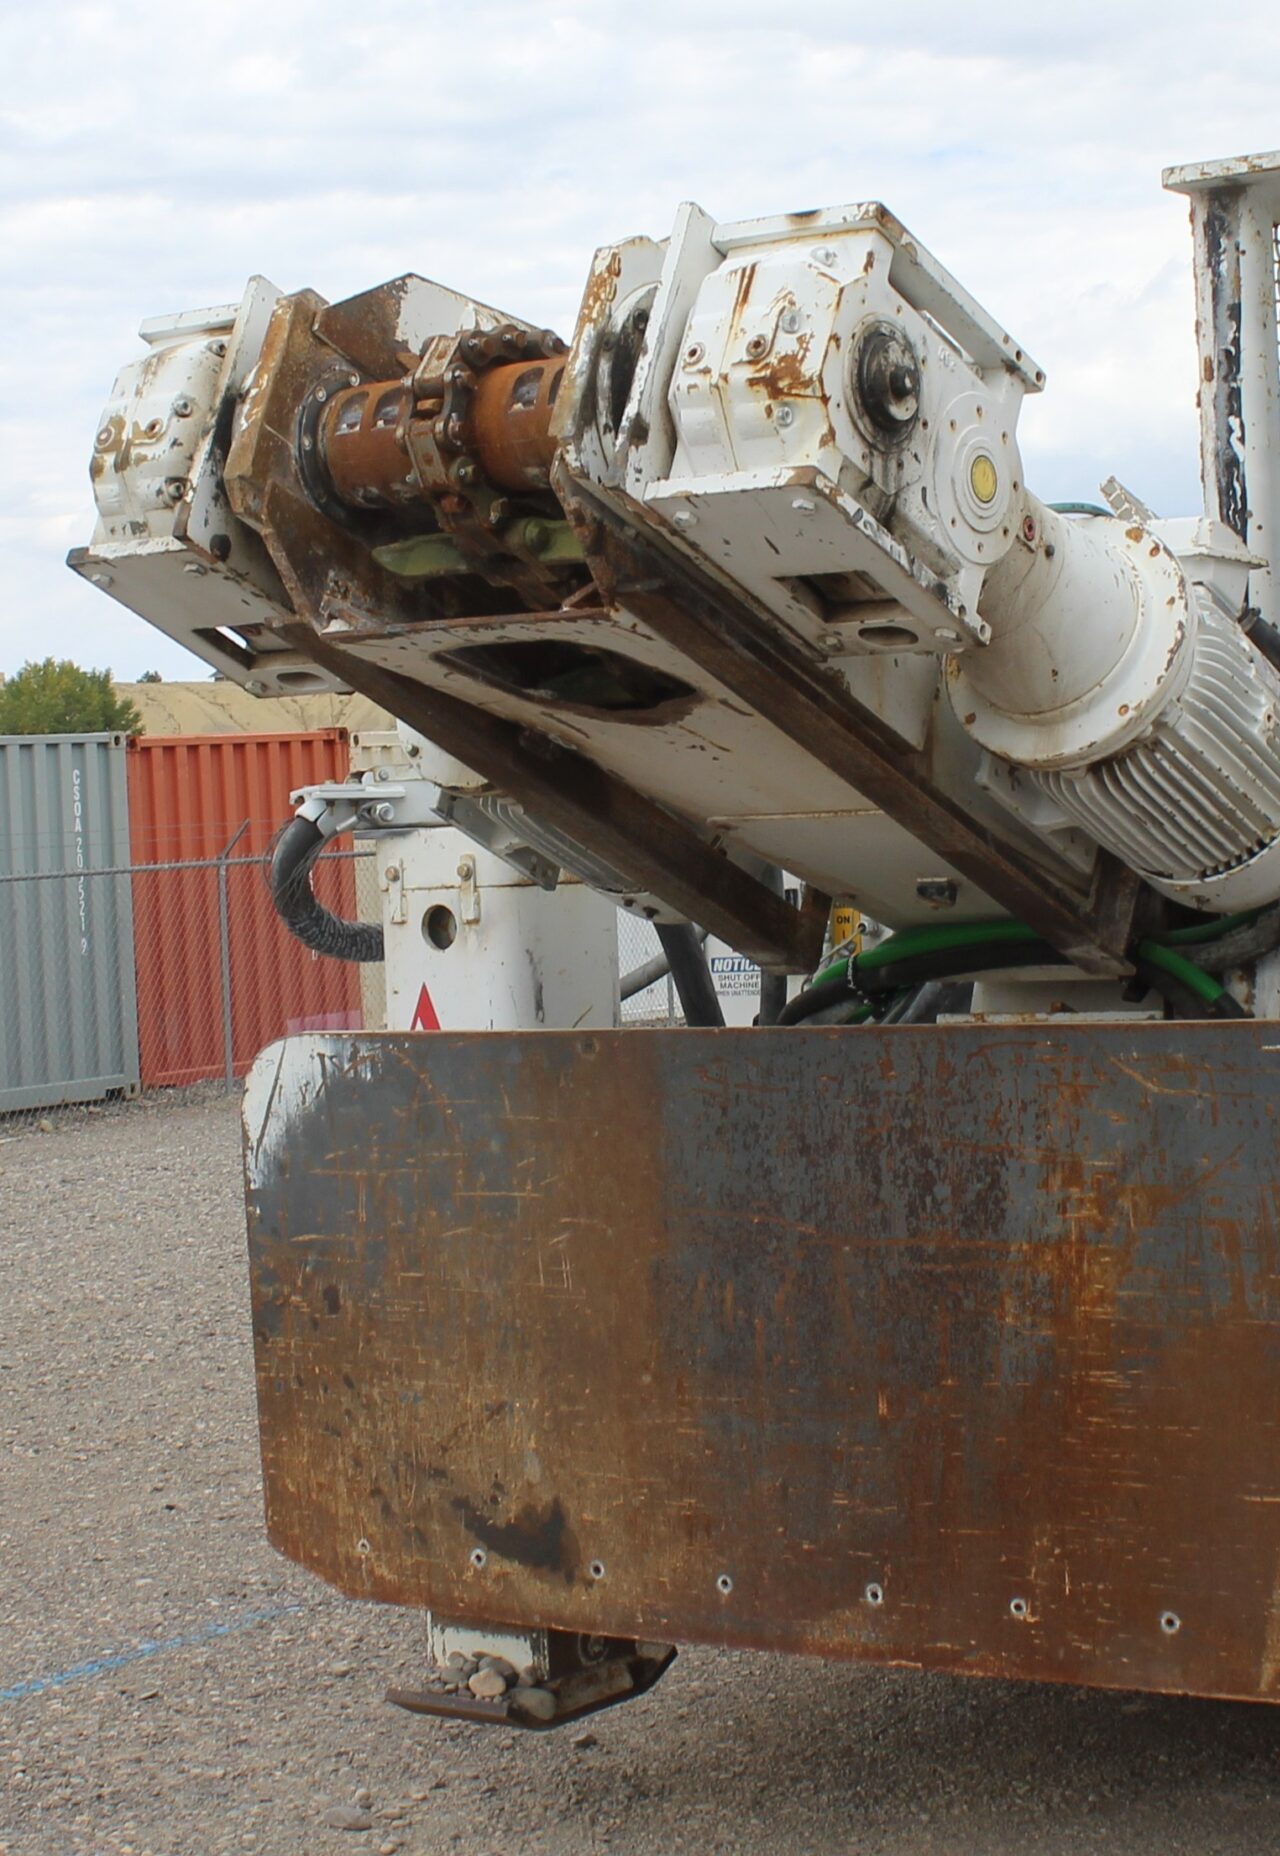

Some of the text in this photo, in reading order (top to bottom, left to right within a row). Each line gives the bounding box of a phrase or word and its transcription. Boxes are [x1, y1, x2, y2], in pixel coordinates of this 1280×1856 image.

[73, 769, 82, 833] CSOA
[836, 915, 850, 925] ON
[718, 973, 760, 982] SHUT OFF
[720, 981, 759, 989] MACHINE
